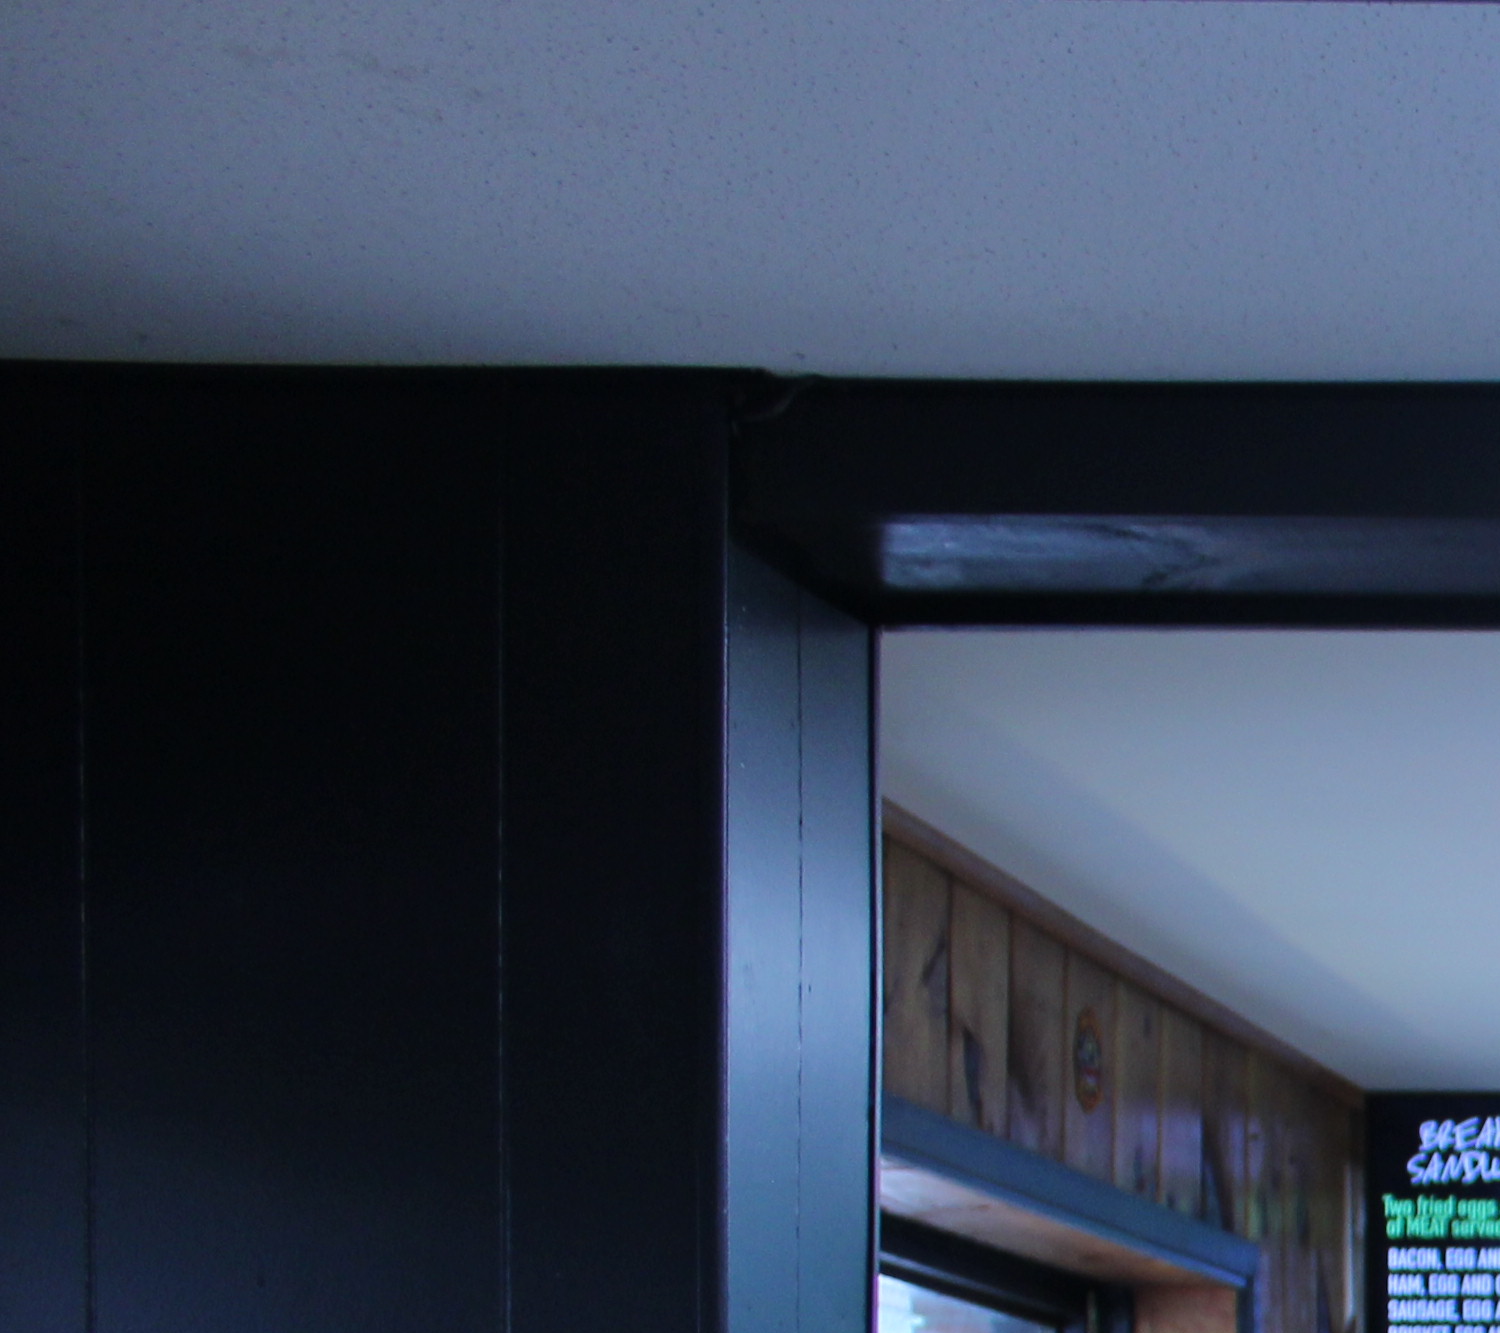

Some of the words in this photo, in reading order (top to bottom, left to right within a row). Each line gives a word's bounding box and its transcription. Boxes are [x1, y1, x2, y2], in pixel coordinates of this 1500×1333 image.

[1388, 1247, 1444, 1271] BACON,
[1445, 1247, 1477, 1271] EGG
[1388, 1274, 1427, 1297] HAM,
[1428, 1274, 1459, 1297] EGG
[1461, 1274, 1494, 1297] AND
[1388, 1299, 1460, 1322] SAUSAGE,
[1462, 1299, 1494, 1322] EGG
